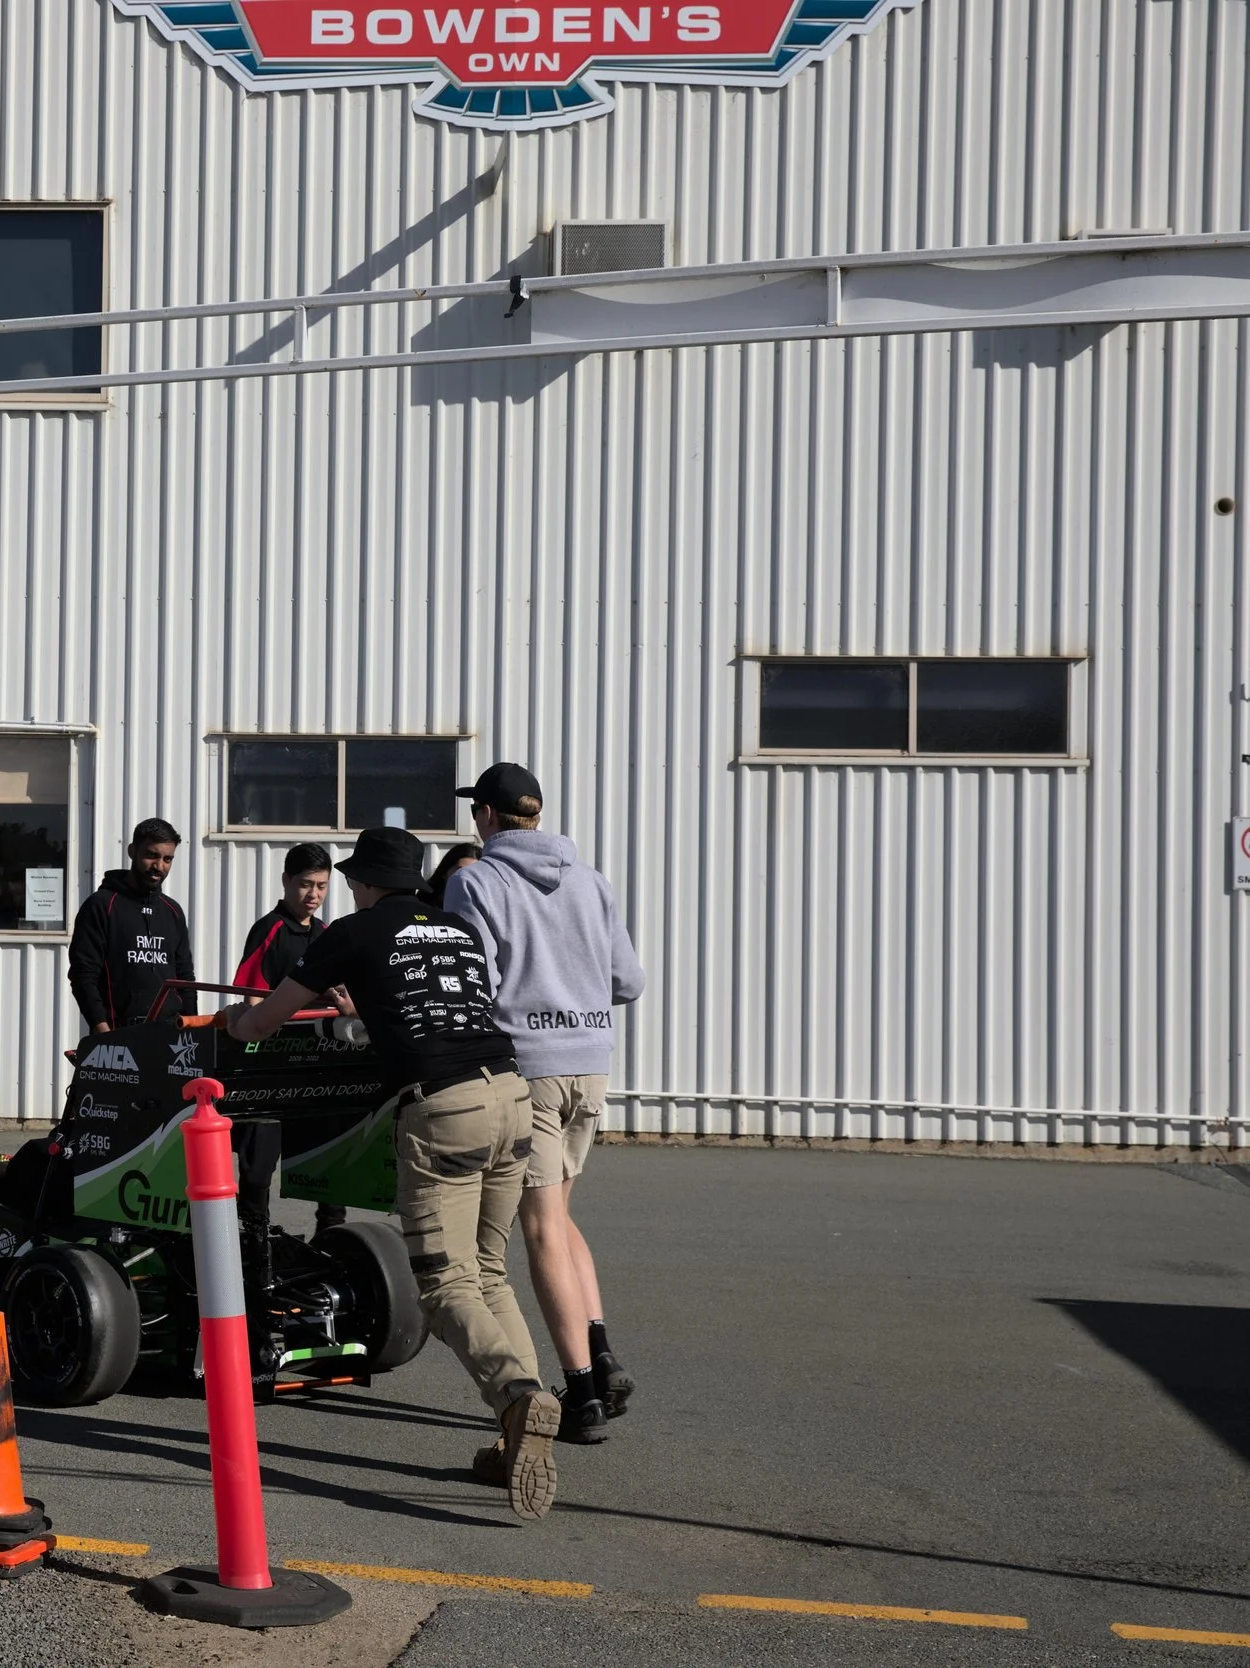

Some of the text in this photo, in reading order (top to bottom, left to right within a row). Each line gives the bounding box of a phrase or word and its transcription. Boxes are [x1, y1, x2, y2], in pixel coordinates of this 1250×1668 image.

[311, 5, 722, 45] BOWDEN'S
[467, 52, 561, 73] OWN
[395, 924, 470, 938] ANCA
[136, 935, 165, 949] RMIT
[396, 937, 474, 946] CNC MACHINES
[127, 950, 168, 965] RACING
[389, 952, 423, 966] Quickstep
[439, 955, 456, 963] SBG
[404, 970, 428, 981] leap
[439, 975, 461, 991] RS
[526, 1009, 612, 1031] GRAD 2021
[80, 1043, 140, 1072] ANCA
[79, 1070, 140, 1084] CNC MACHINES
[216, 1083, 382, 1103] MEBODY SAY DON DONS?
[78, 1093, 119, 1122] Quickstep
[90, 1134, 111, 1150] SBG
[252, 1373, 275, 1385] eyShot
